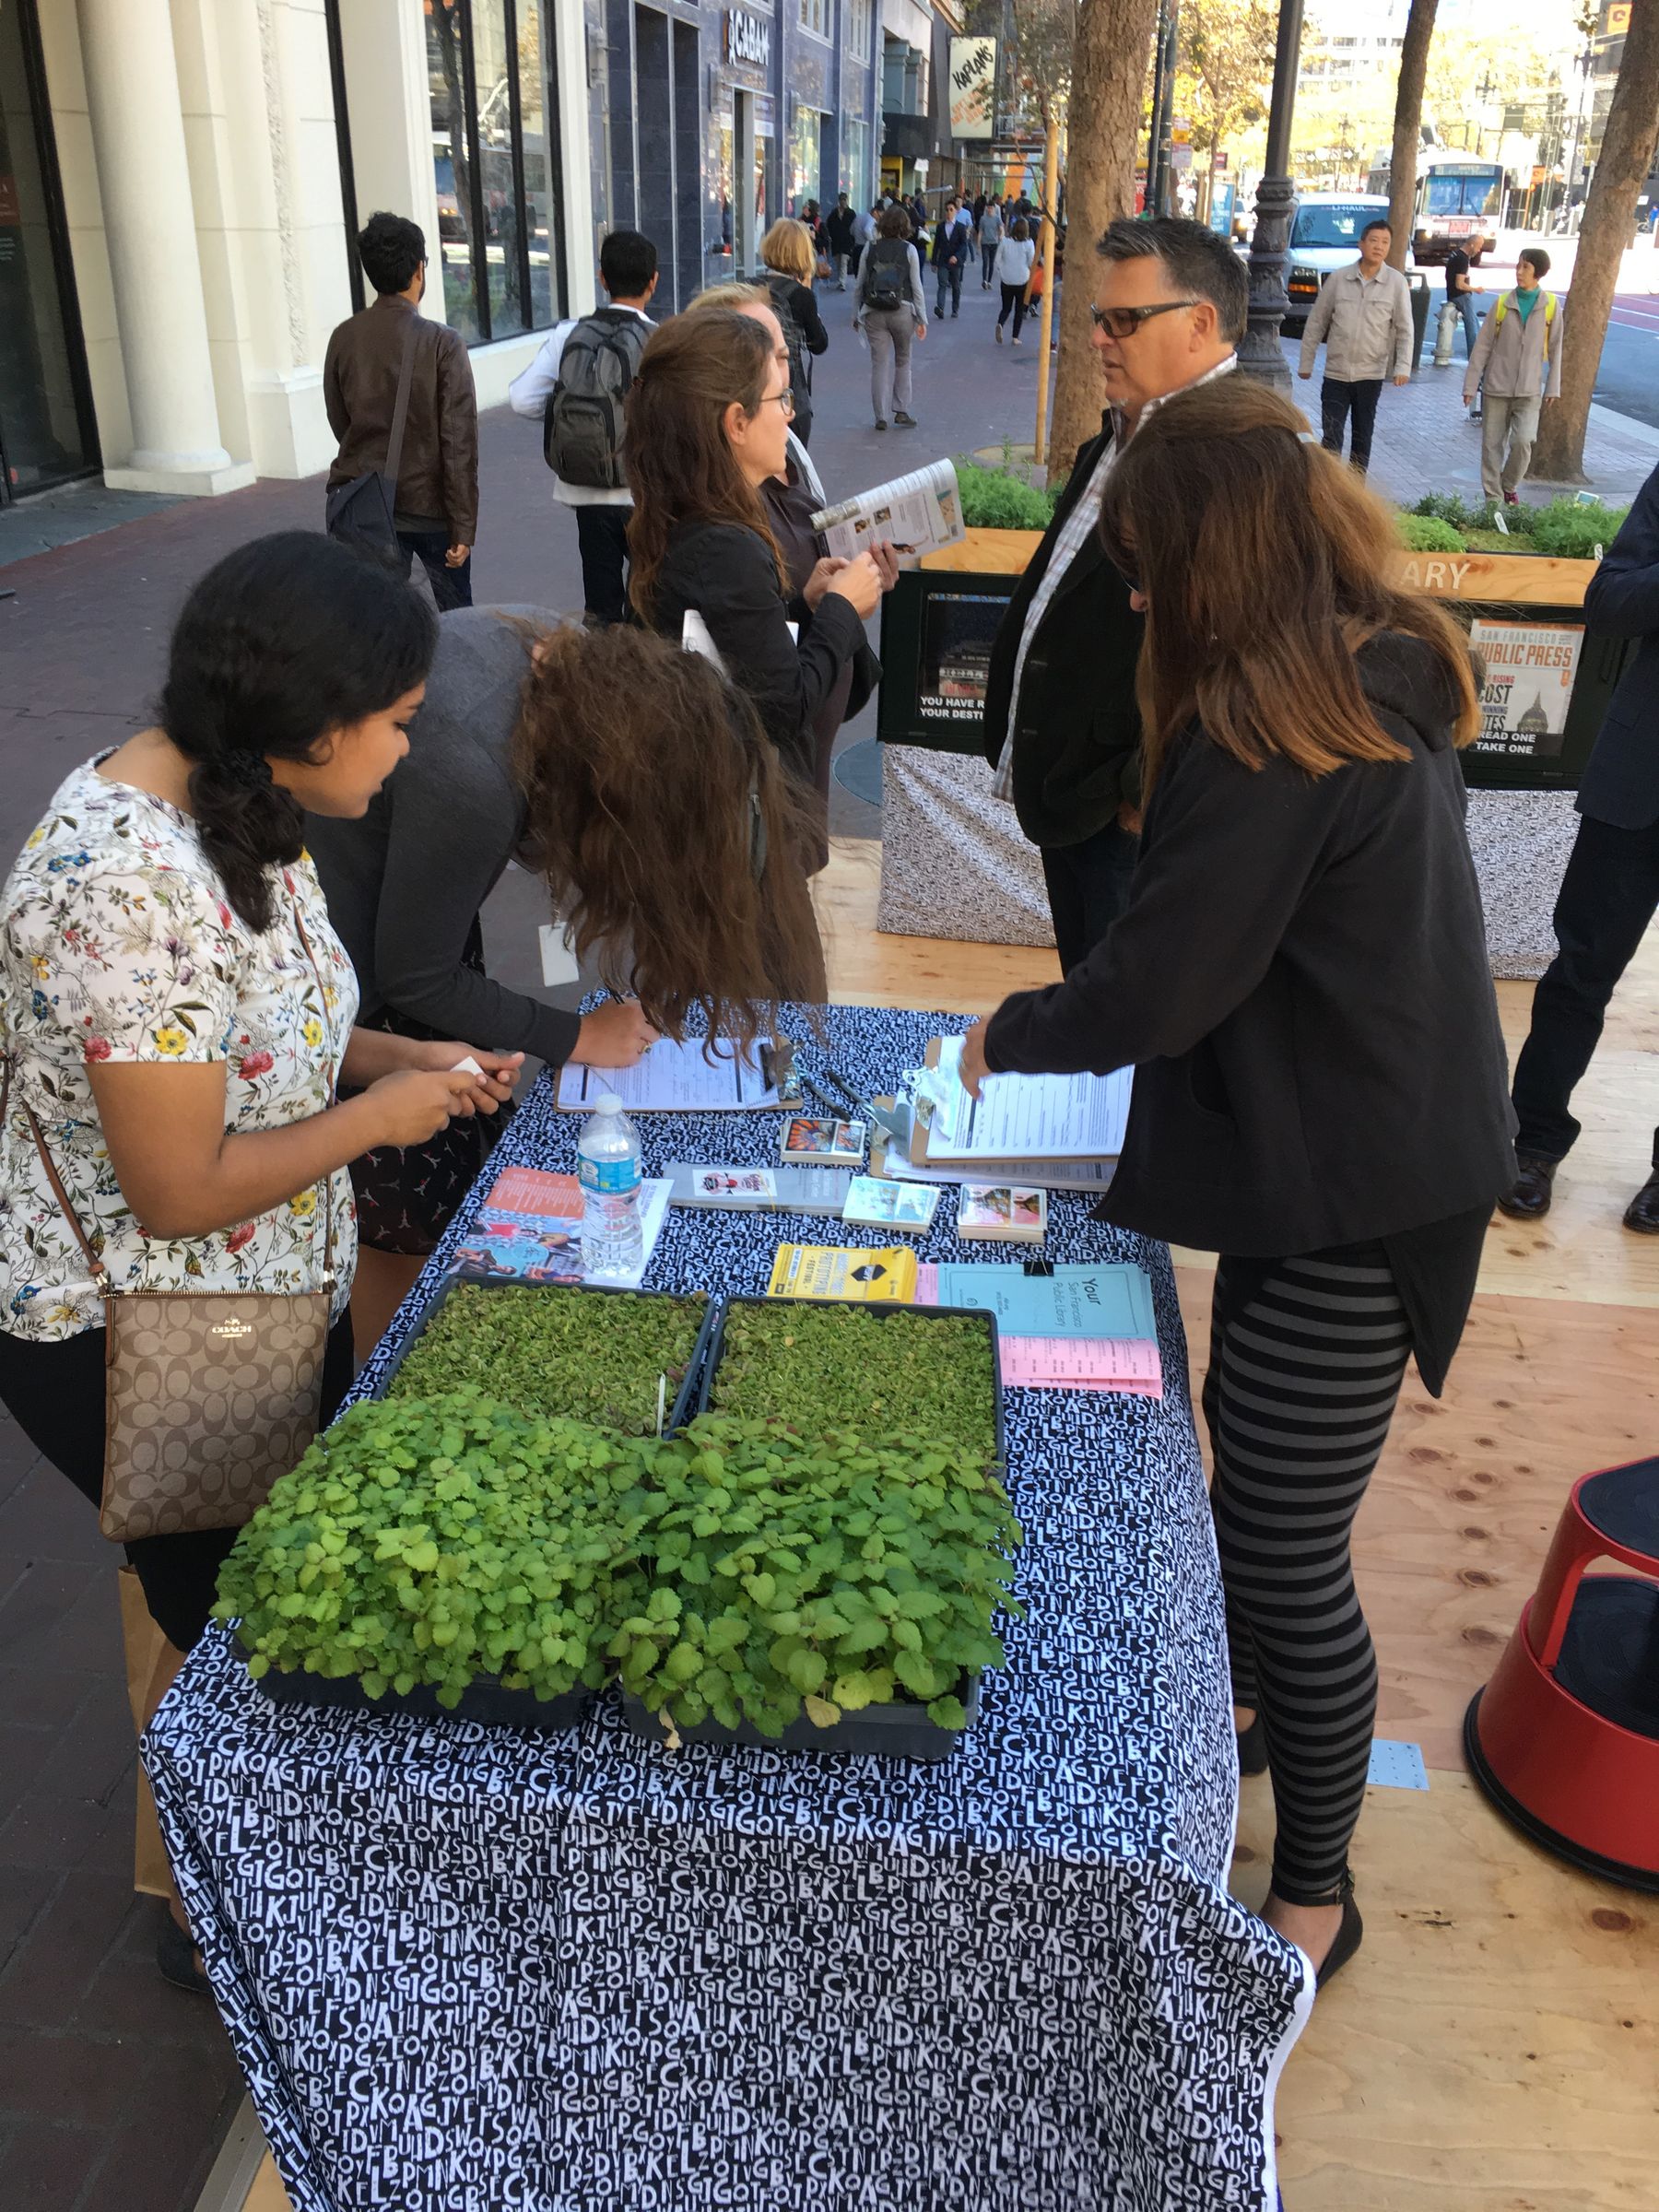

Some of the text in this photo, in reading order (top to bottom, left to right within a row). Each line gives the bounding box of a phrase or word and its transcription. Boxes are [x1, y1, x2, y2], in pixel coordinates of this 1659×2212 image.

[952, 40, 994, 90] KAPLAN'S
[1480, 629, 1500, 642] SAN
[1502, 631, 1557, 645] FRANCISCO
[1525, 644, 1573, 667] PRESS
[920, 696, 943, 707] YOU
[946, 698, 975, 709] HAVE
[919, 707, 950, 719] YOUR
[1512, 733, 1536, 743] ONE
[1476, 741, 1534, 755] TAKE ONE
[1082, 1277, 1101, 1305] Your
[1068, 1282, 1082, 1327] San Francisco
[212, 1325, 252, 1334] COACH
